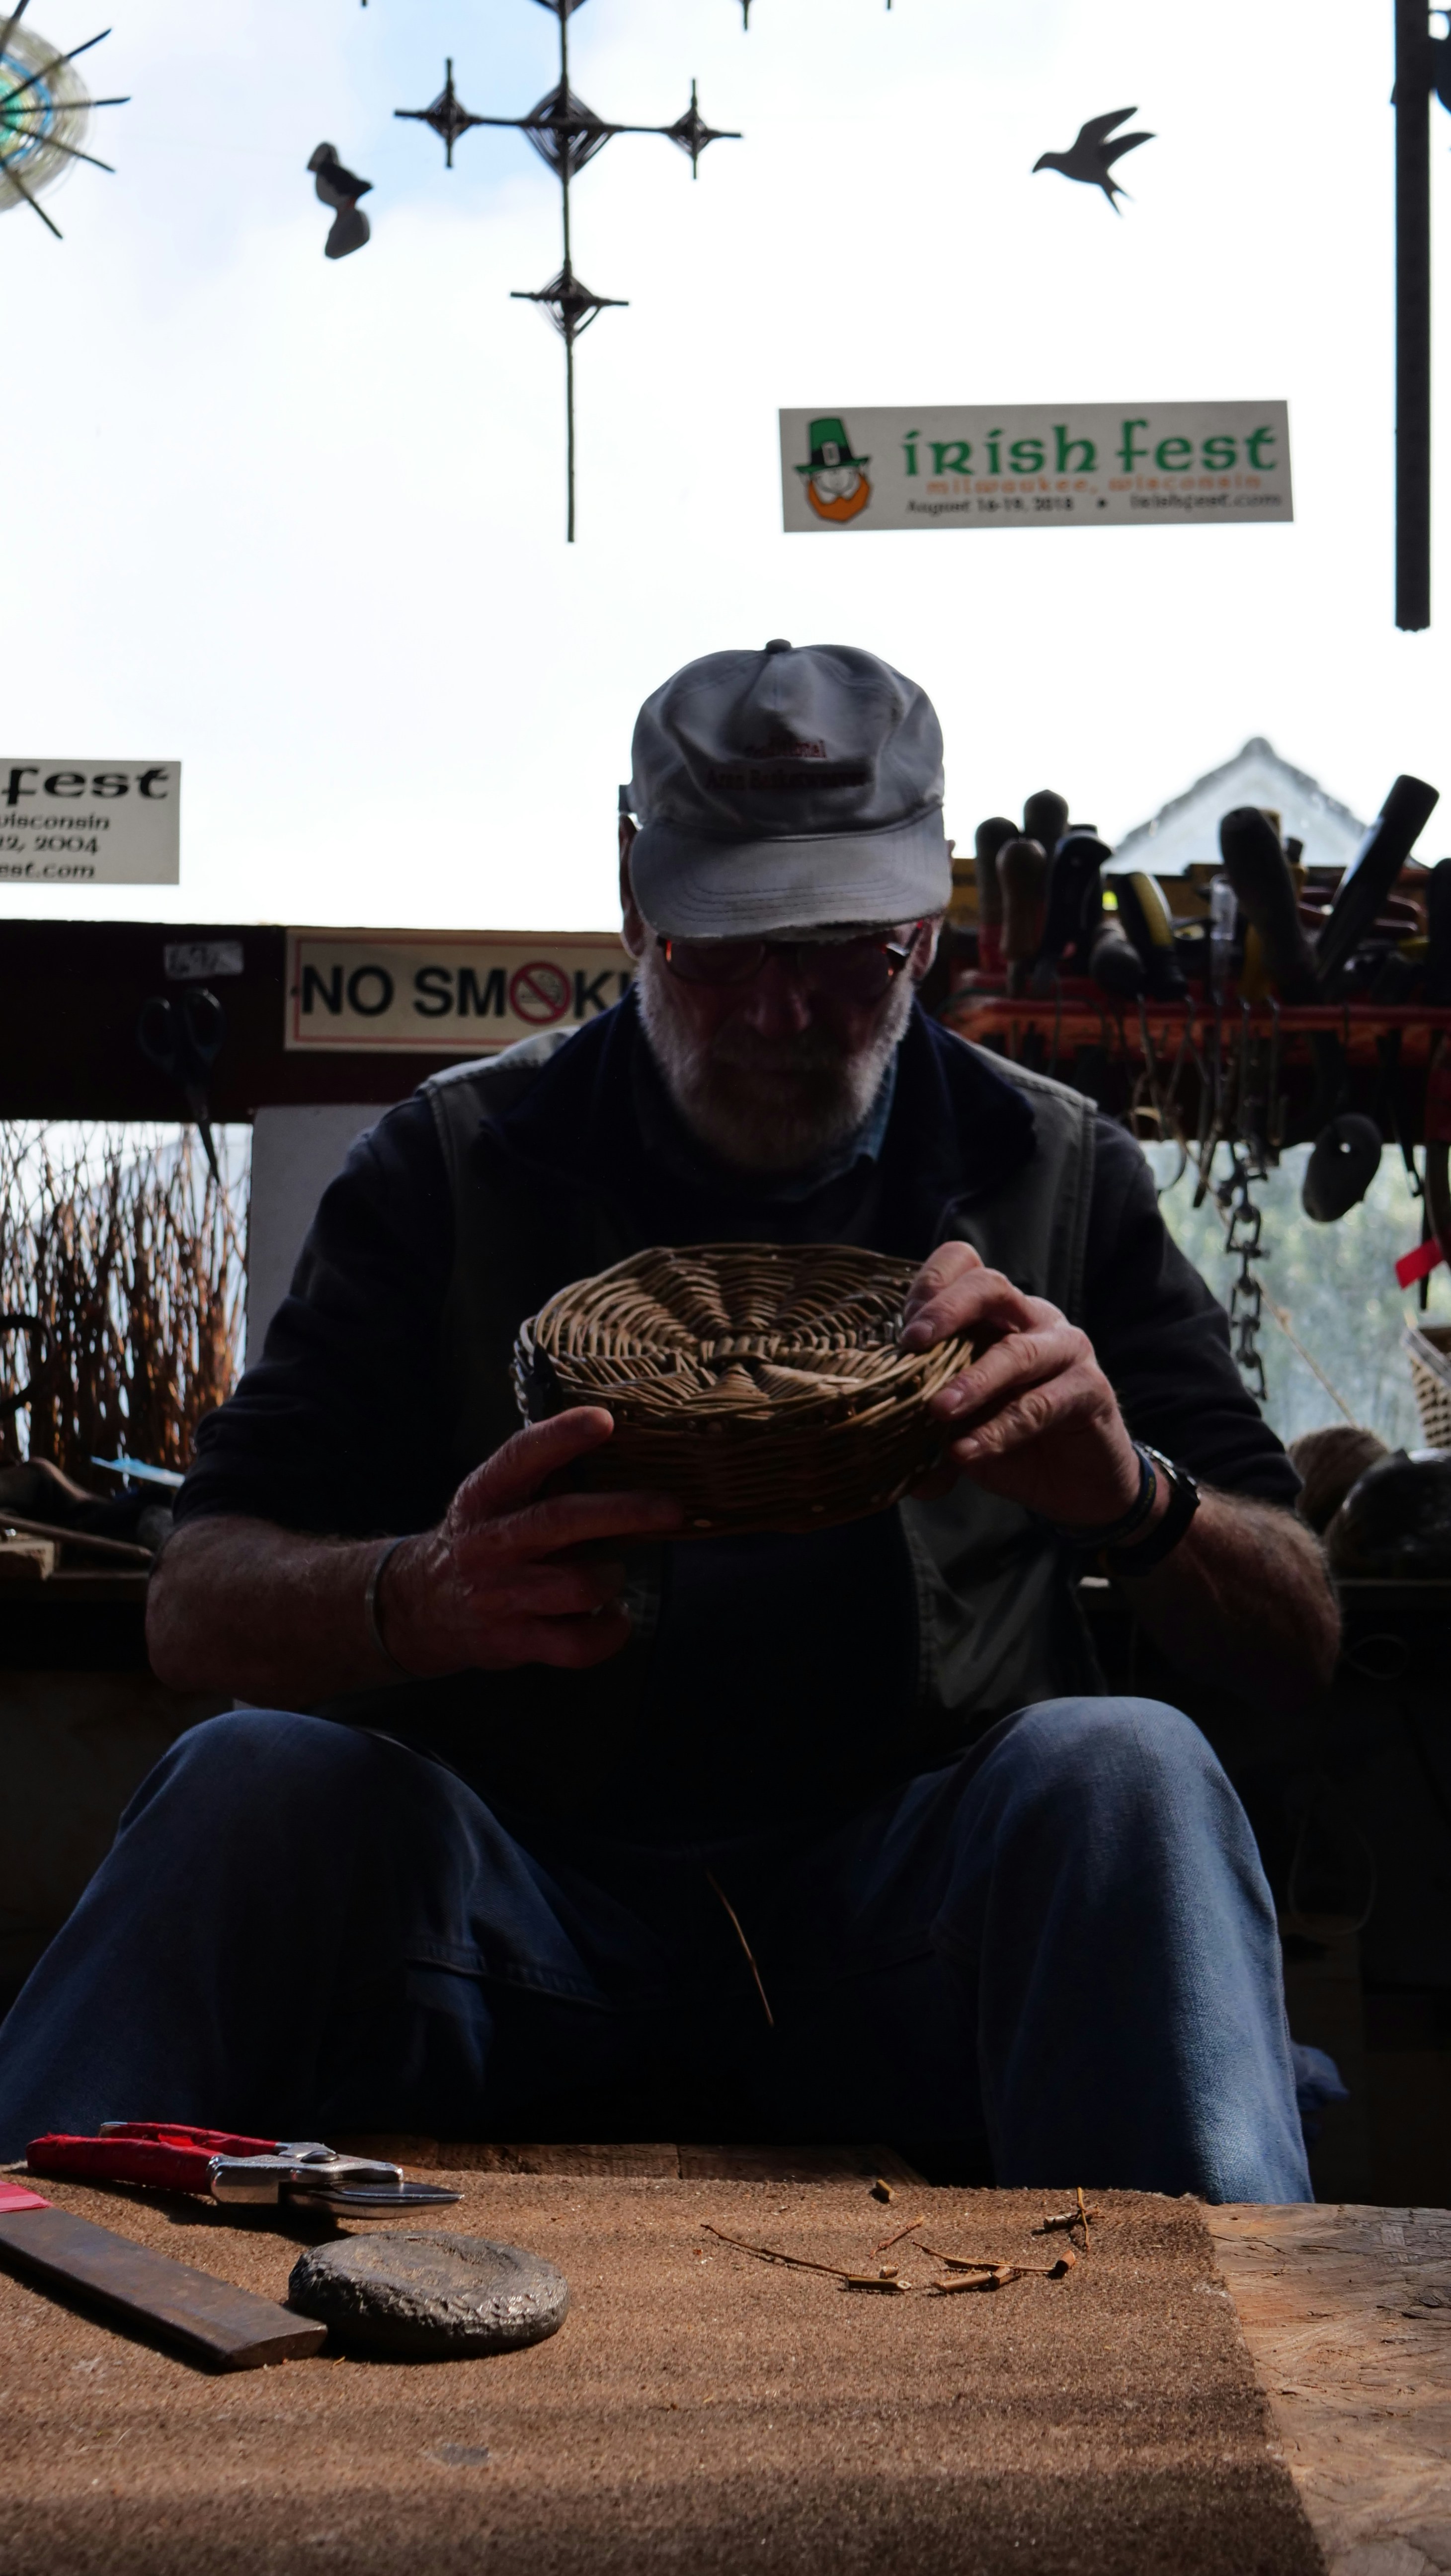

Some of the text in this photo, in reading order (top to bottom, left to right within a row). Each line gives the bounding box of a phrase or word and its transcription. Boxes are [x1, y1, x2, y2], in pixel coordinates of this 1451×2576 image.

[1117, 418, 1278, 474] fest
[1, 766, 169, 807] fest
[34, 835, 100, 856] 2004
[302, 965, 395, 1017] NO
